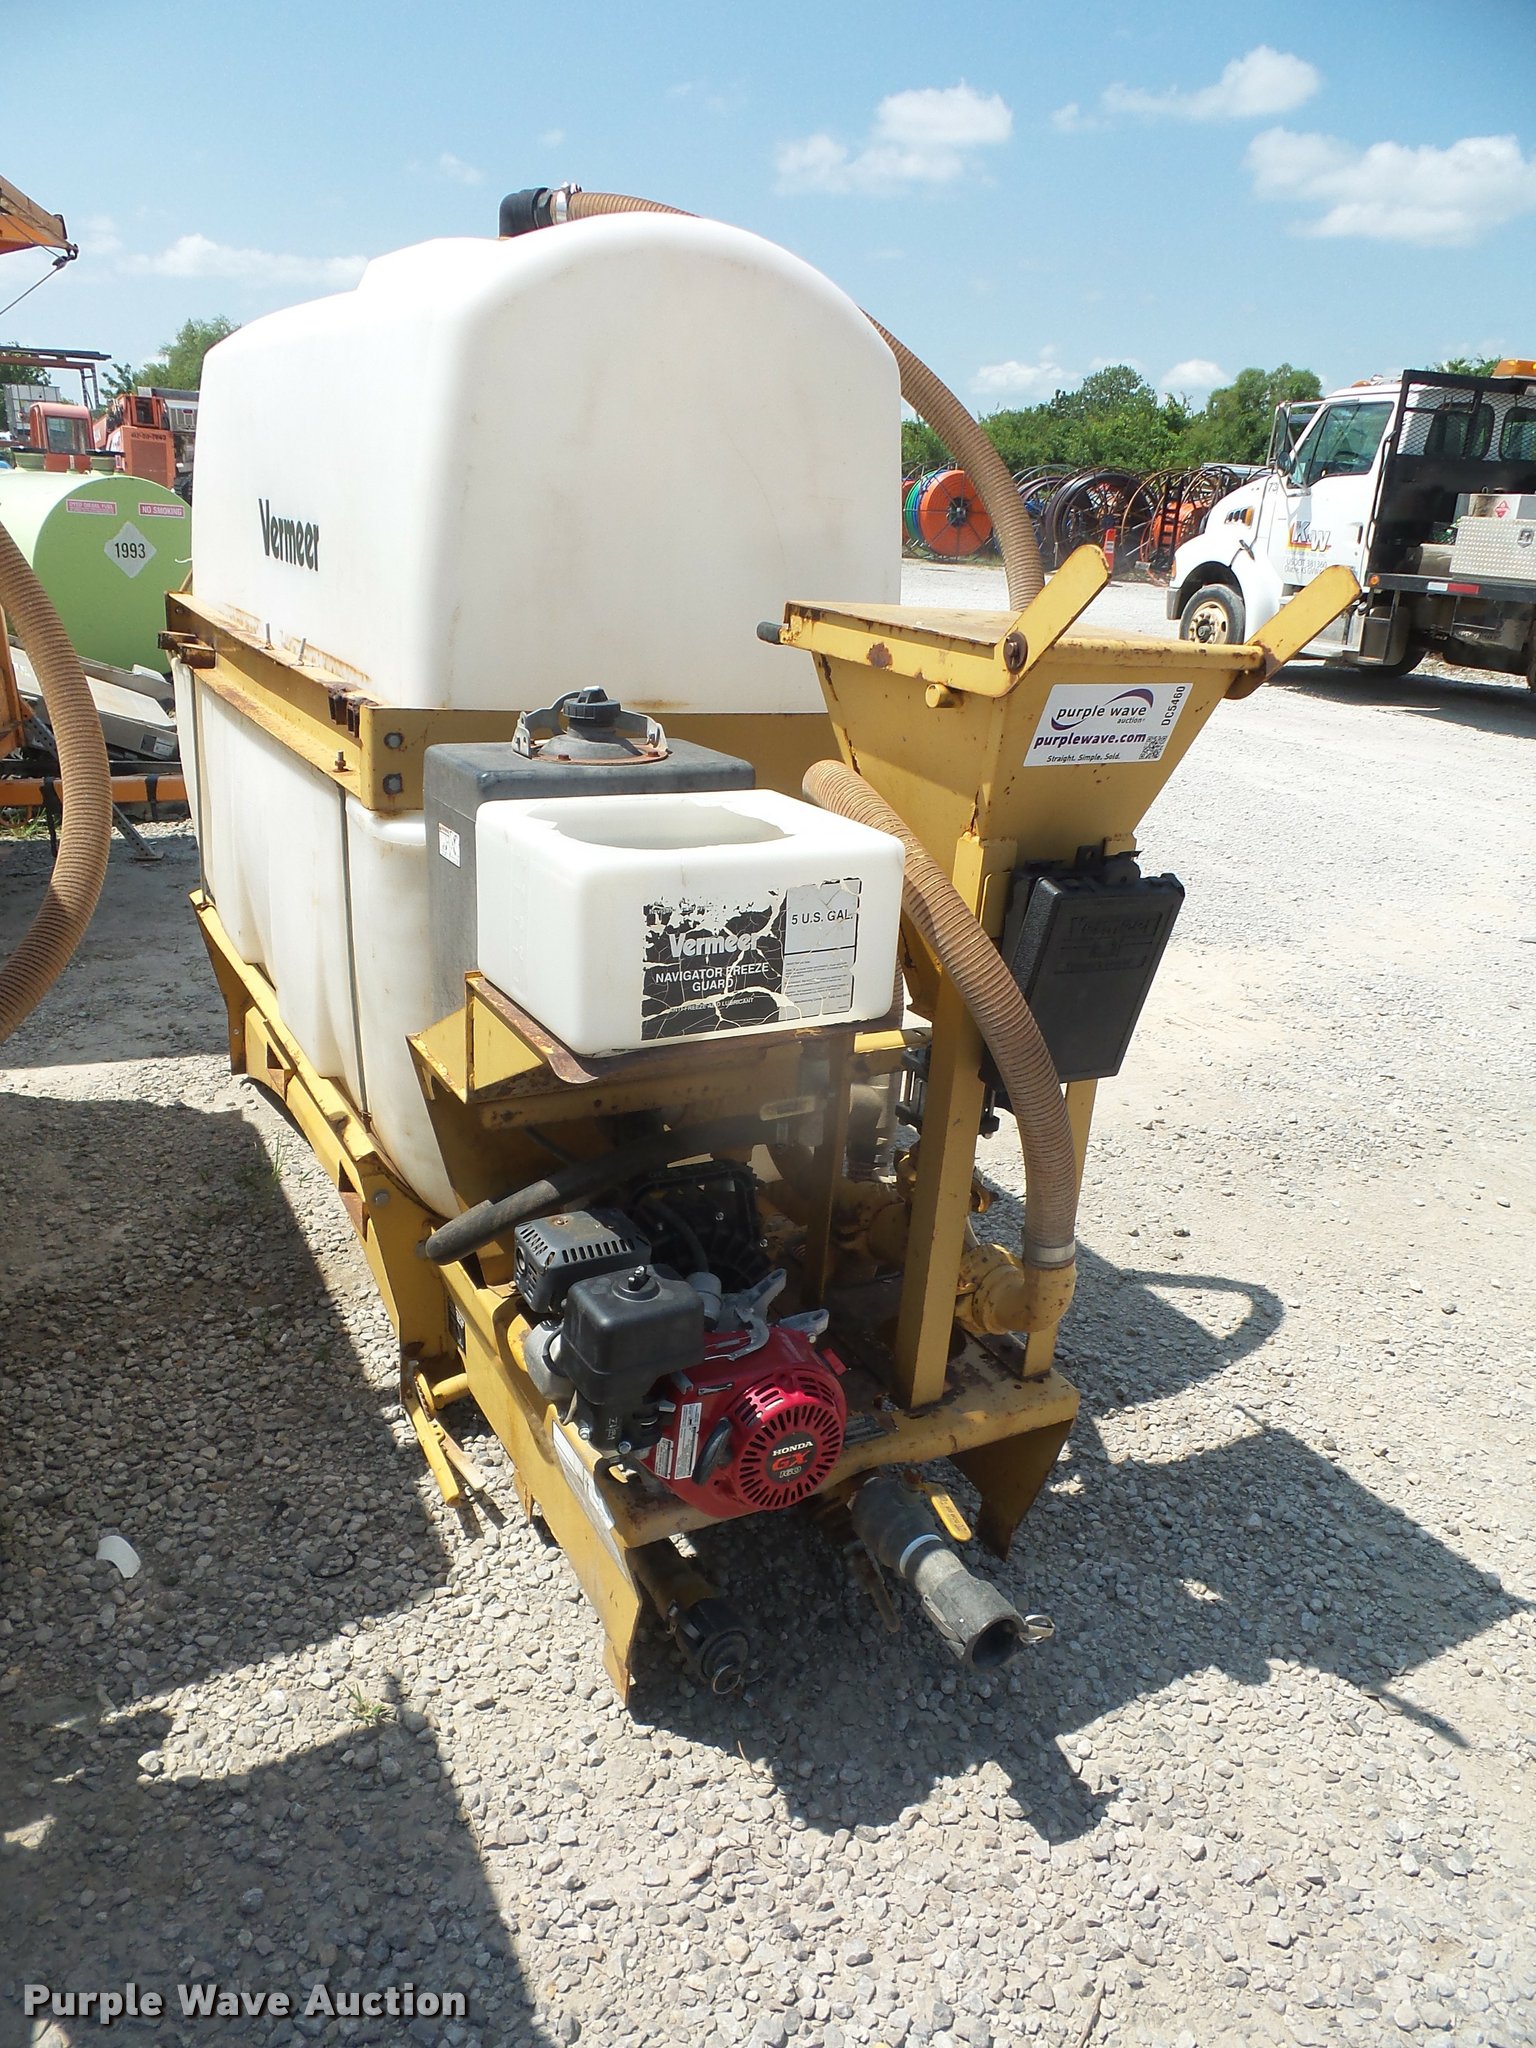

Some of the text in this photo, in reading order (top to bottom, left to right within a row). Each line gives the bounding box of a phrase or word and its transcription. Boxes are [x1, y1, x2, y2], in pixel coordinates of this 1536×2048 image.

[153, 506, 182, 516] SMOKING
[258, 498, 319, 571] Vermeer
[114, 543, 146, 560] 1993
[1055, 704, 1146, 721] purple wave
[1161, 685, 1186, 726] DC5460
[1033, 732, 1147, 749] purplewave.com
[1046, 752, 1121, 763] Straight. Simple. Sold.
[792, 909, 853, 925] 5 U.S. GAL.
[669, 932, 760, 958] Vermeer
[655, 962, 769, 983] NAVIGATOR FREEZE
[693, 975, 734, 992] GUARD
[772, 1441, 813, 1456] HONDA
[772, 1450, 811, 1472] GX
